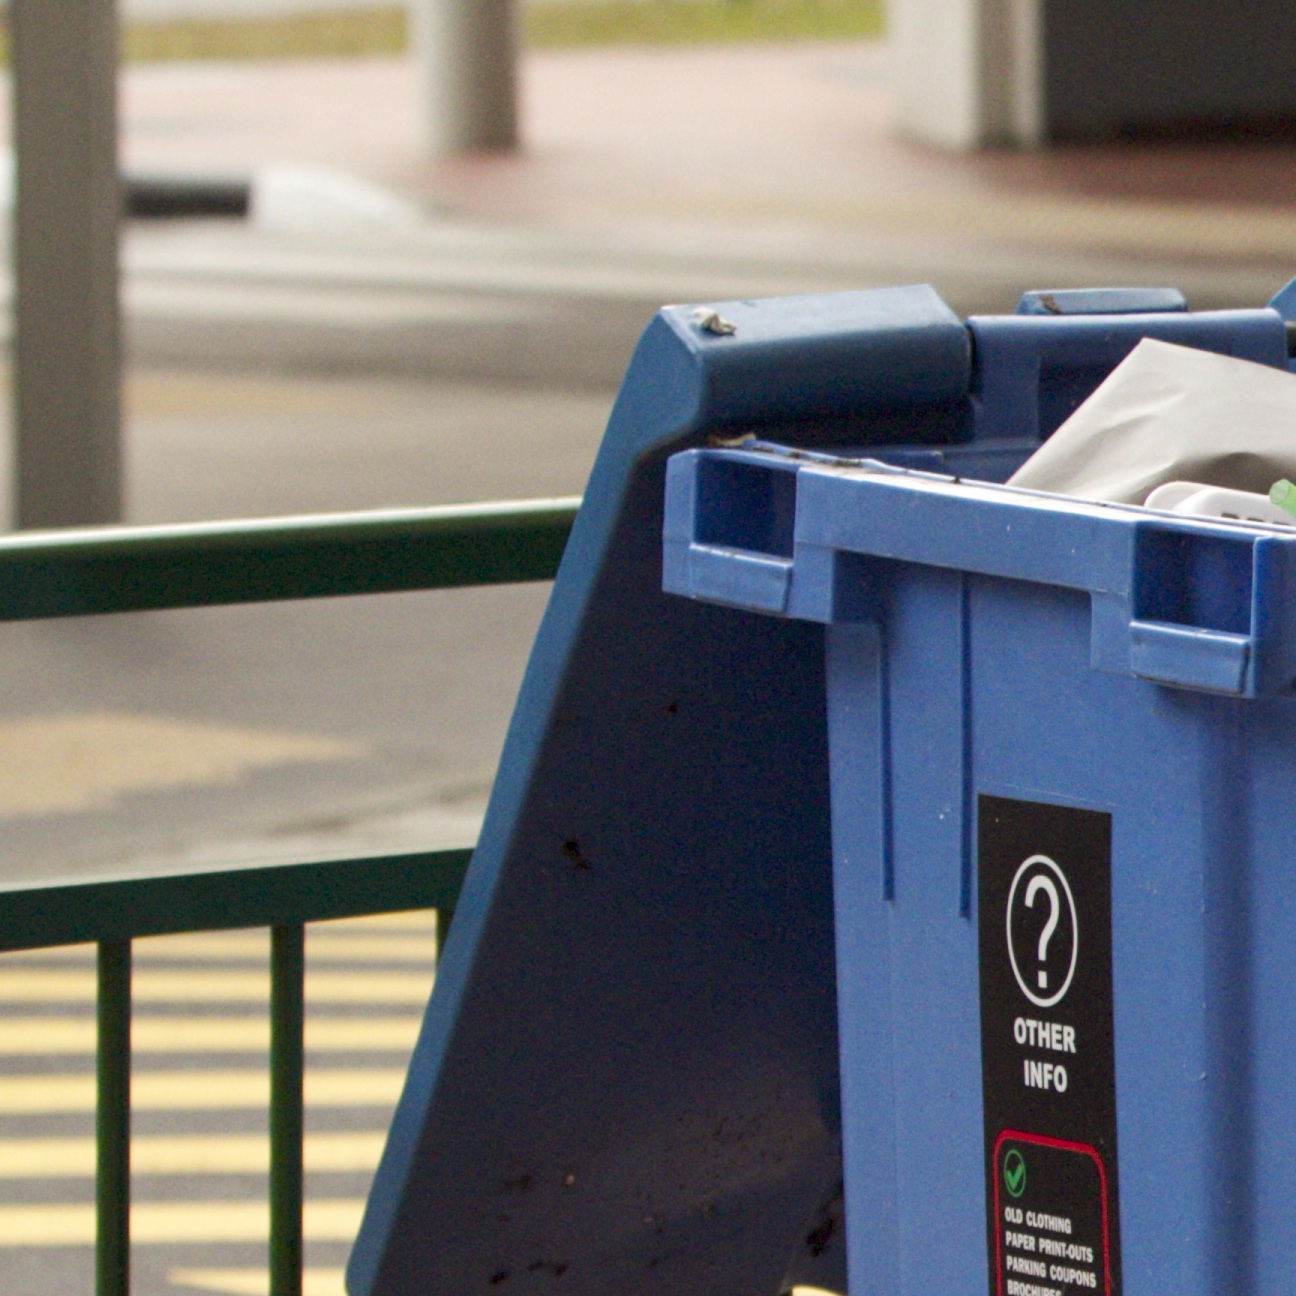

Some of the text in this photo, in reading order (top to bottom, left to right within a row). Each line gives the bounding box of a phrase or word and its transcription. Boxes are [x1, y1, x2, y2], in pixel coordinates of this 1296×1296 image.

[1013, 1017, 1076, 1053] OTHER
[1024, 1060, 1067, 1092] INFO
[1005, 1206, 1071, 1234] OLD CLOTHING
[1006, 1231, 1093, 1263] PAPER PRINT-OUTS
[1007, 1256, 1097, 1288] PARKING COUPONS
